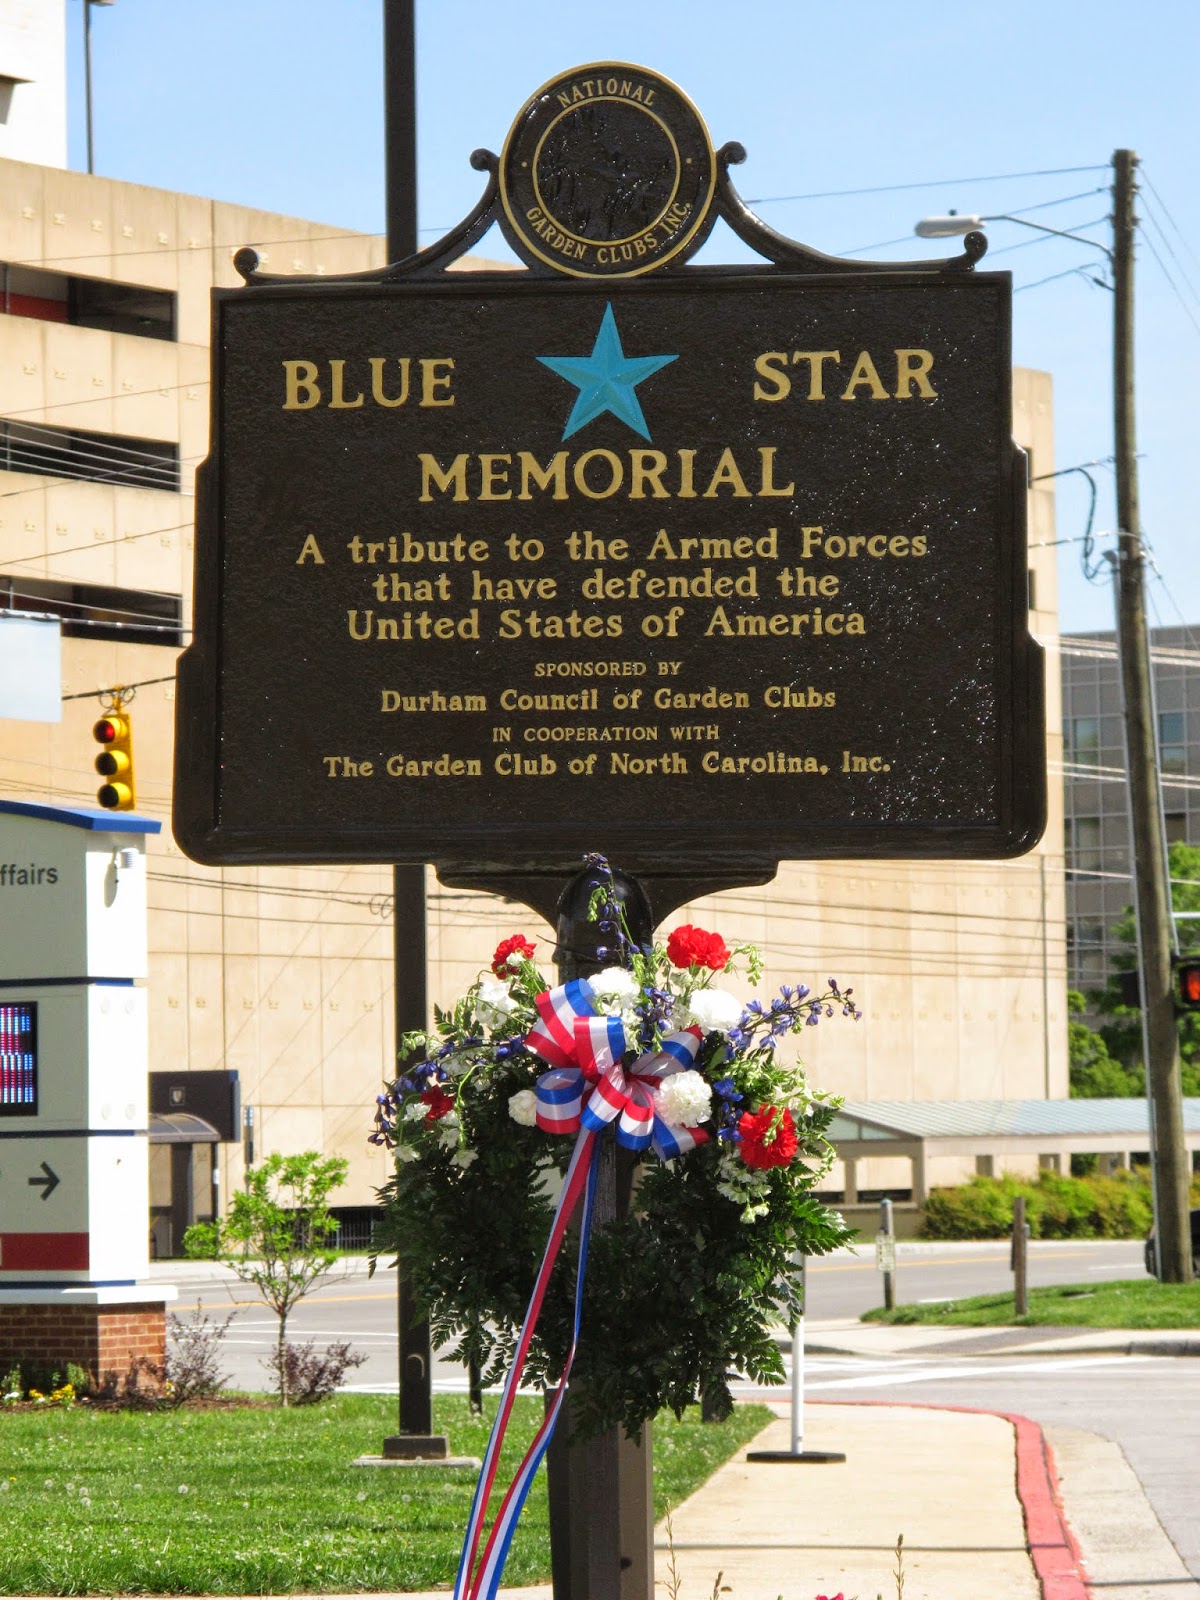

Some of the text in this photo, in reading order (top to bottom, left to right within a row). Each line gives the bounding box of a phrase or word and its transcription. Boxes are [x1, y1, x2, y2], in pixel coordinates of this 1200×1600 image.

[556, 77, 656, 108] NATIONAL
[526, 202, 692, 264] GARDEN CLUBS INC.
[281, 348, 939, 410] BLUE STAR
[417, 446, 795, 502] MEMORIAL
[295, 525, 927, 565] A tribute to the Armed Forces
[372, 566, 840, 602] that have defended the
[347, 605, 867, 641] United States of America
[534, 661, 682, 677] SPONSORED BY
[381, 685, 837, 712] Durham Council of Garden Clubs
[492, 725, 719, 742] IN COOPERATION WITH
[323, 750, 891, 777] The Garden Club of North Carolina, Inc.
